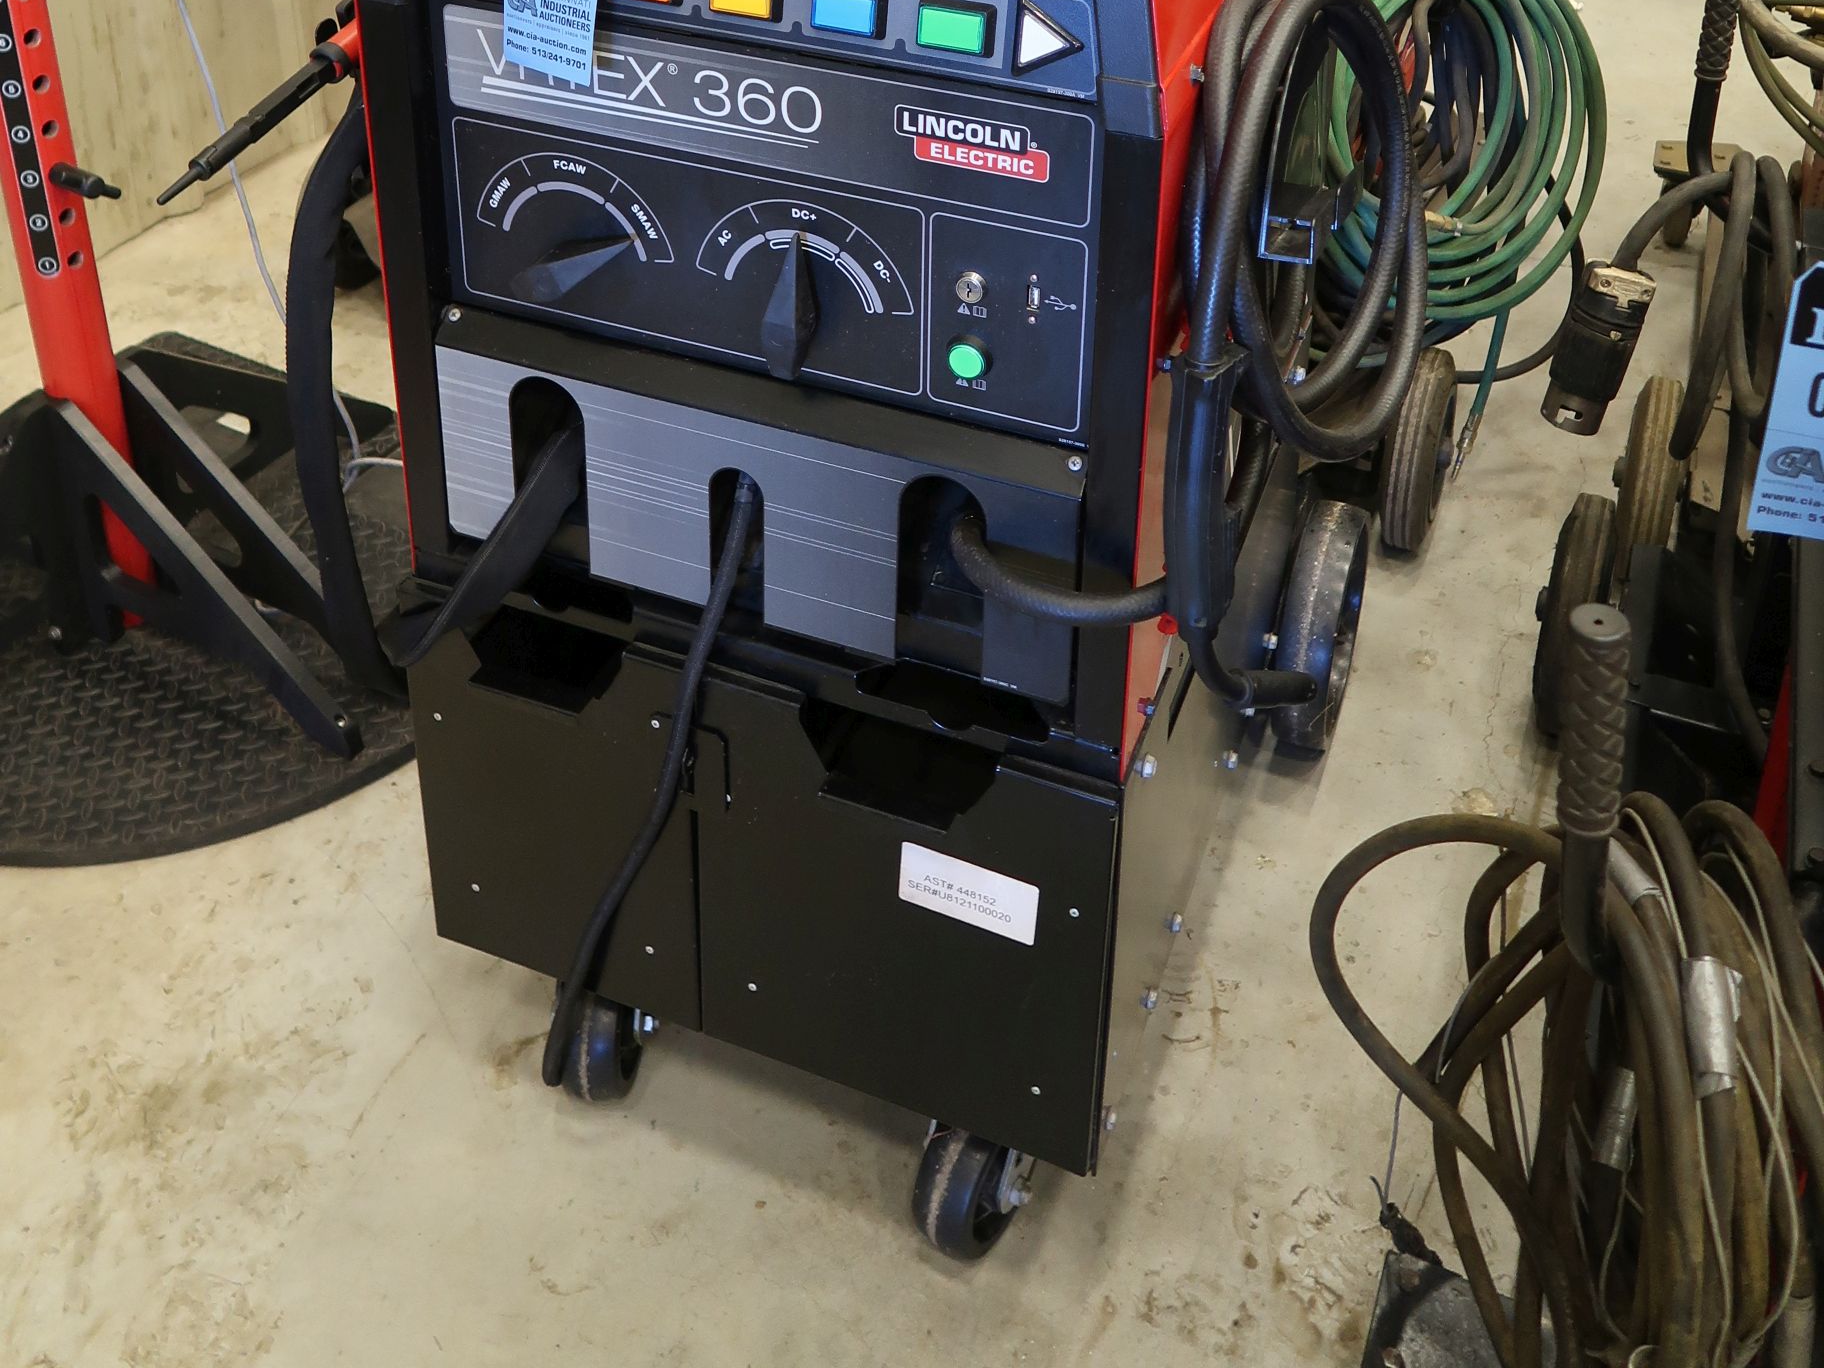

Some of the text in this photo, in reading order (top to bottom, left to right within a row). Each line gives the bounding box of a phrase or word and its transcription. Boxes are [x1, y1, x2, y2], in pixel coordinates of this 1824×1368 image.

[538, 11, 591, 33] AUCTIONEERS
[506, 38, 587, 71] Phone: 513/241-9701
[507, 25, 587, 56] www.cia-auction.com
[693, 69, 823, 133] 360
[902, 111, 1021, 151] LINCOLN
[553, 159, 587, 175] FCAW
[930, 142, 1035, 176] ELECTRIC
[489, 177, 512, 209] GMAW
[630, 203, 658, 241] SMAW
[791, 208, 818, 222] DC+
[717, 229, 733, 247] AC
[873, 260, 893, 284] DC-
[1757, 505, 1802, 520] Phone:
[907, 879, 1012, 924] SER#U8121100020
[923, 874, 997, 907] AST# 448152
